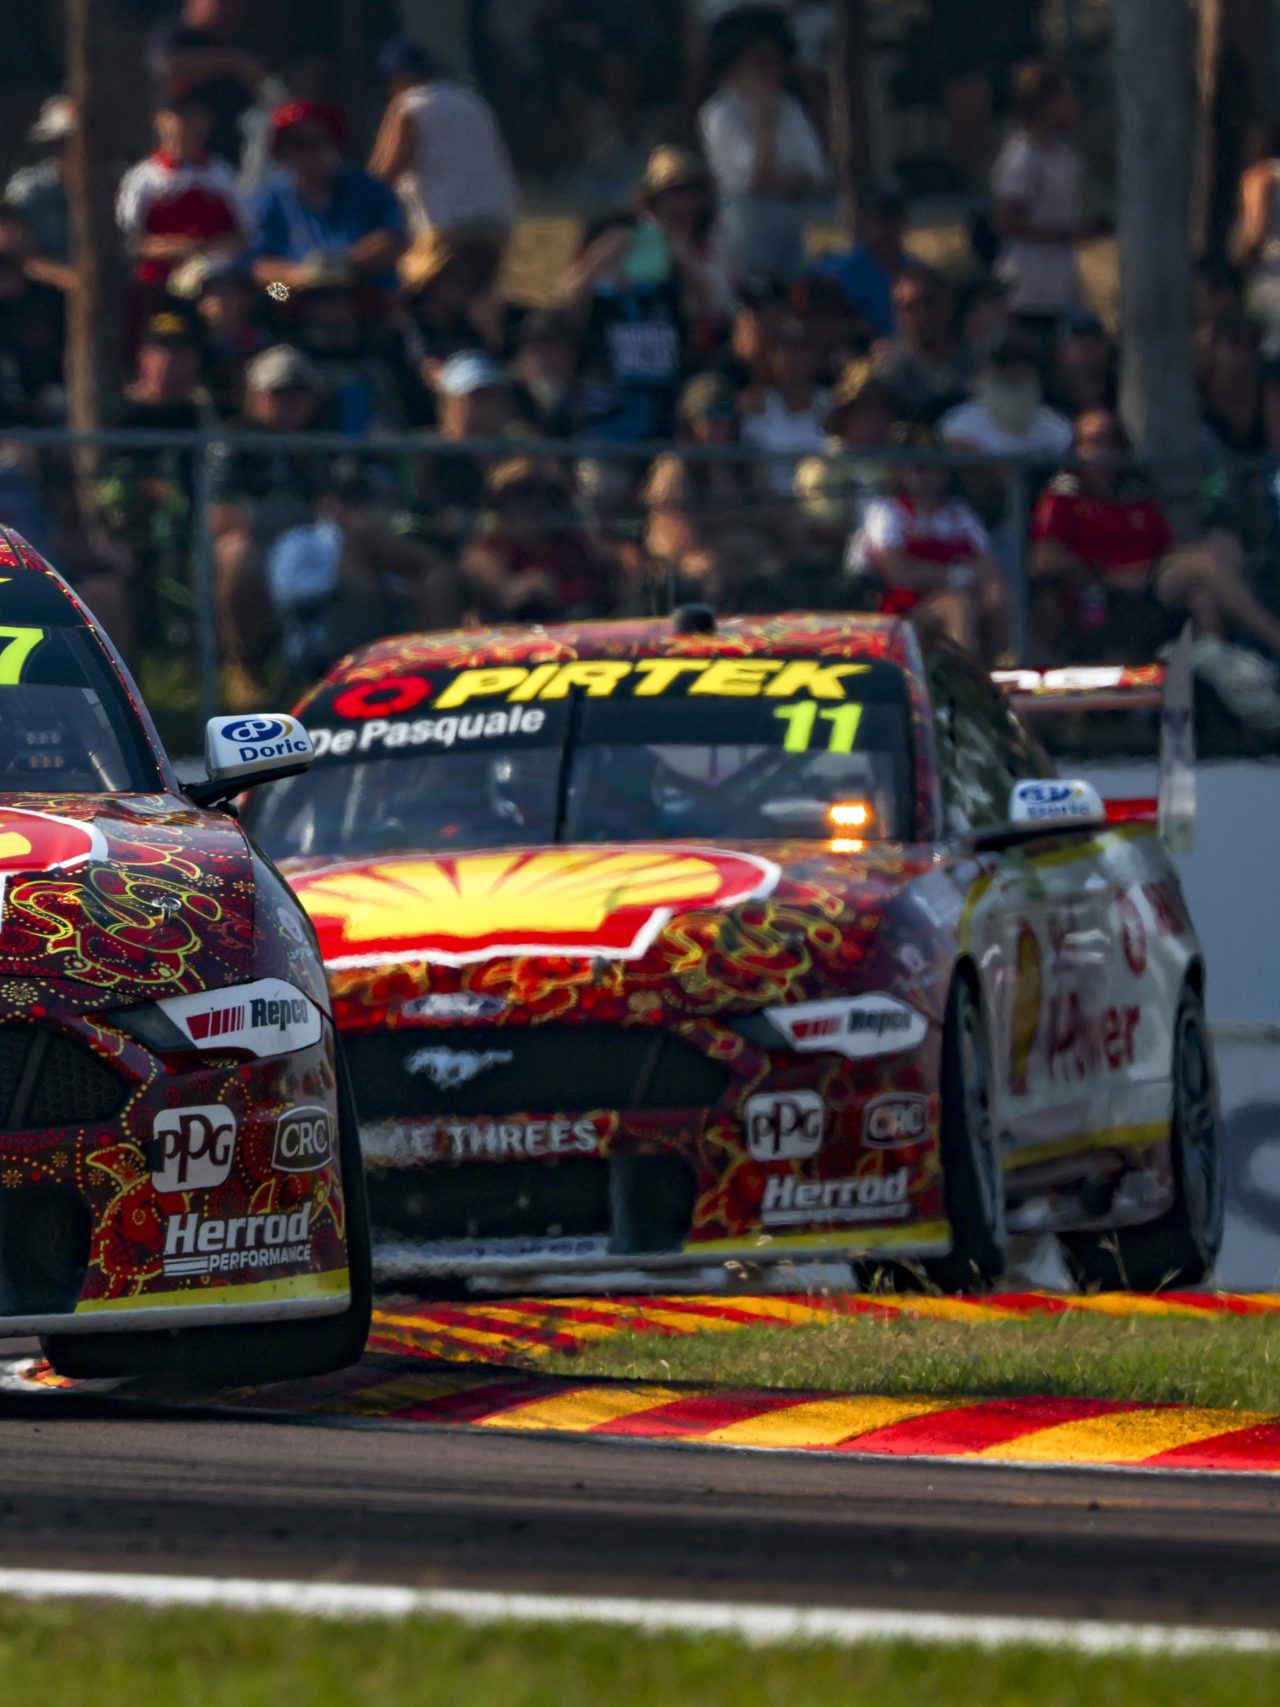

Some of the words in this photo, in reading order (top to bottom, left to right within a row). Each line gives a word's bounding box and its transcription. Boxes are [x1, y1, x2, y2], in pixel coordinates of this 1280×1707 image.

[432, 658, 871, 710] PIRTEK
[239, 739, 308, 762] Doric
[308, 728, 357, 758] De
[360, 706, 546, 748] Pasquale
[773, 701, 863, 754] 11
[249, 998, 308, 1031] Repco
[157, 1114, 233, 1183] PPG
[280, 1119, 329, 1159] CRC
[447, 1118, 599, 1155] THREES
[752, 1102, 820, 1154] PPG
[761, 1166, 908, 1209] Herrod
[163, 1202, 313, 1256] Herrod
[209, 1243, 312, 1273] PERFORMANCE
